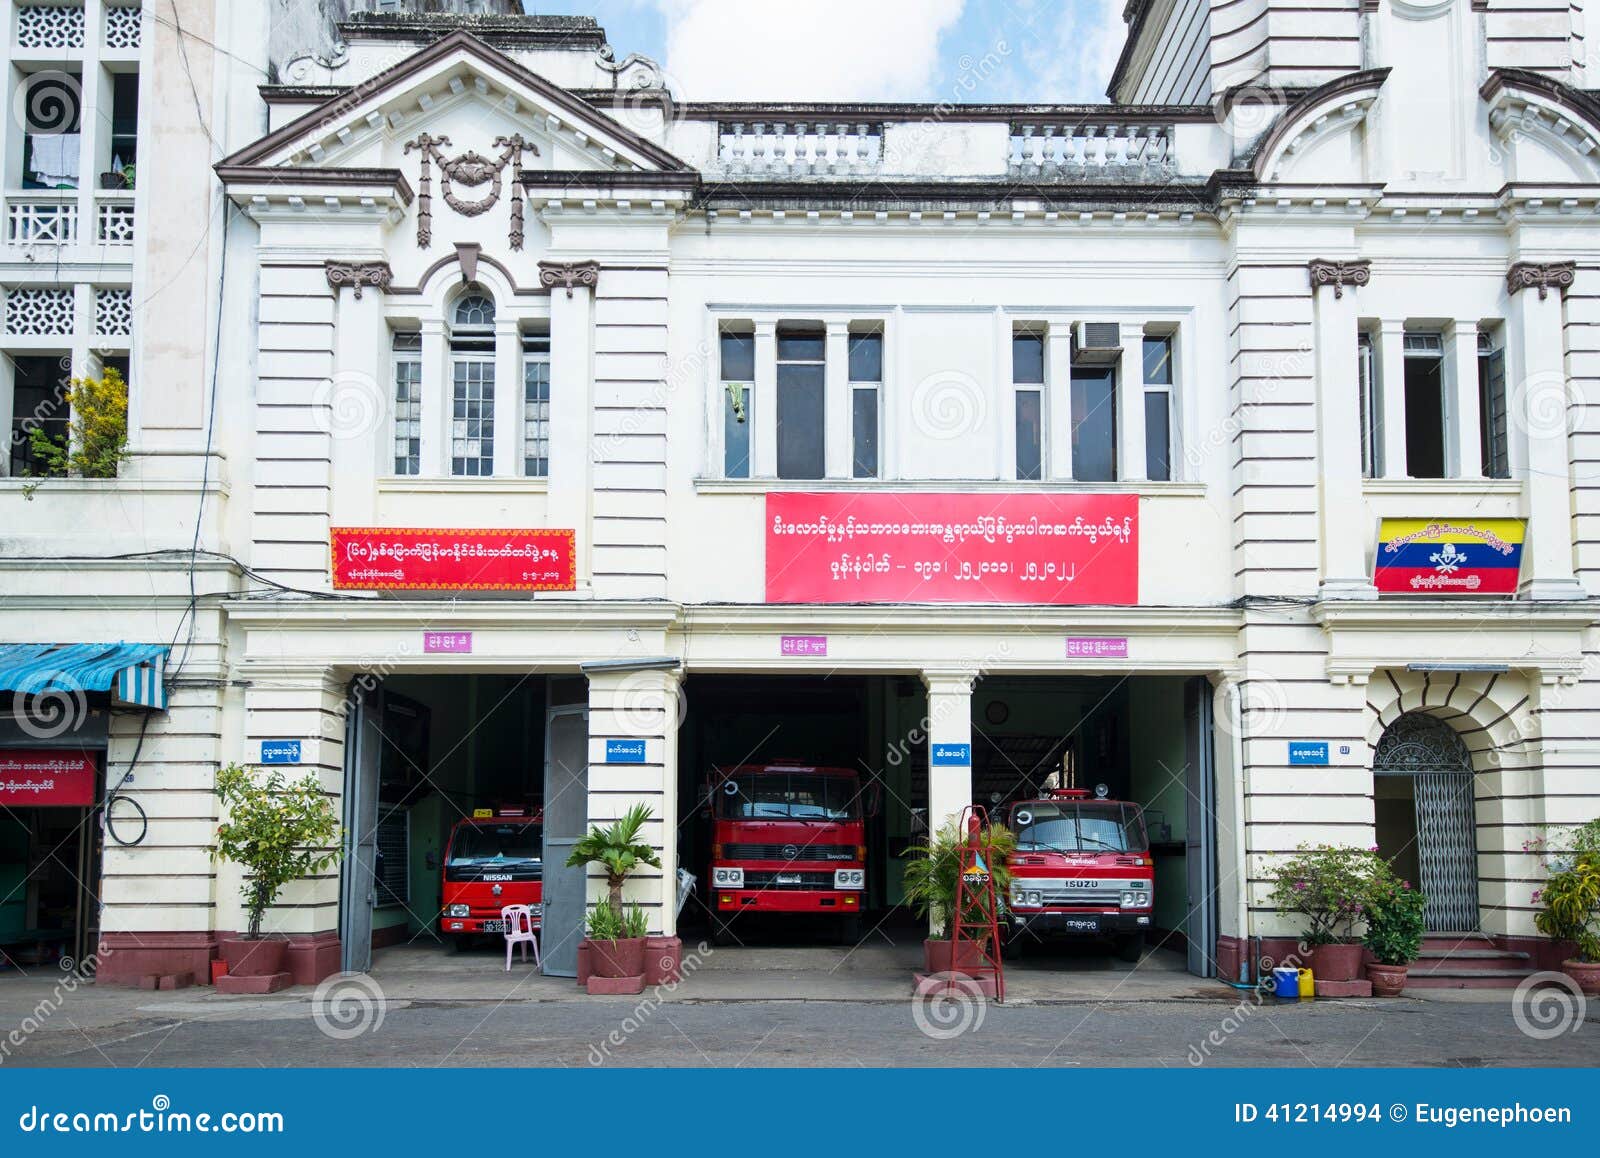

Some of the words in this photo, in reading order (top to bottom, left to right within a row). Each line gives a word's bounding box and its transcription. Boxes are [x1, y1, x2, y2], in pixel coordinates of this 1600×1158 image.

[830, 553, 891, 580] ဖုန်းနံပါတ်
[1065, 880, 1099, 888] ISUZU
